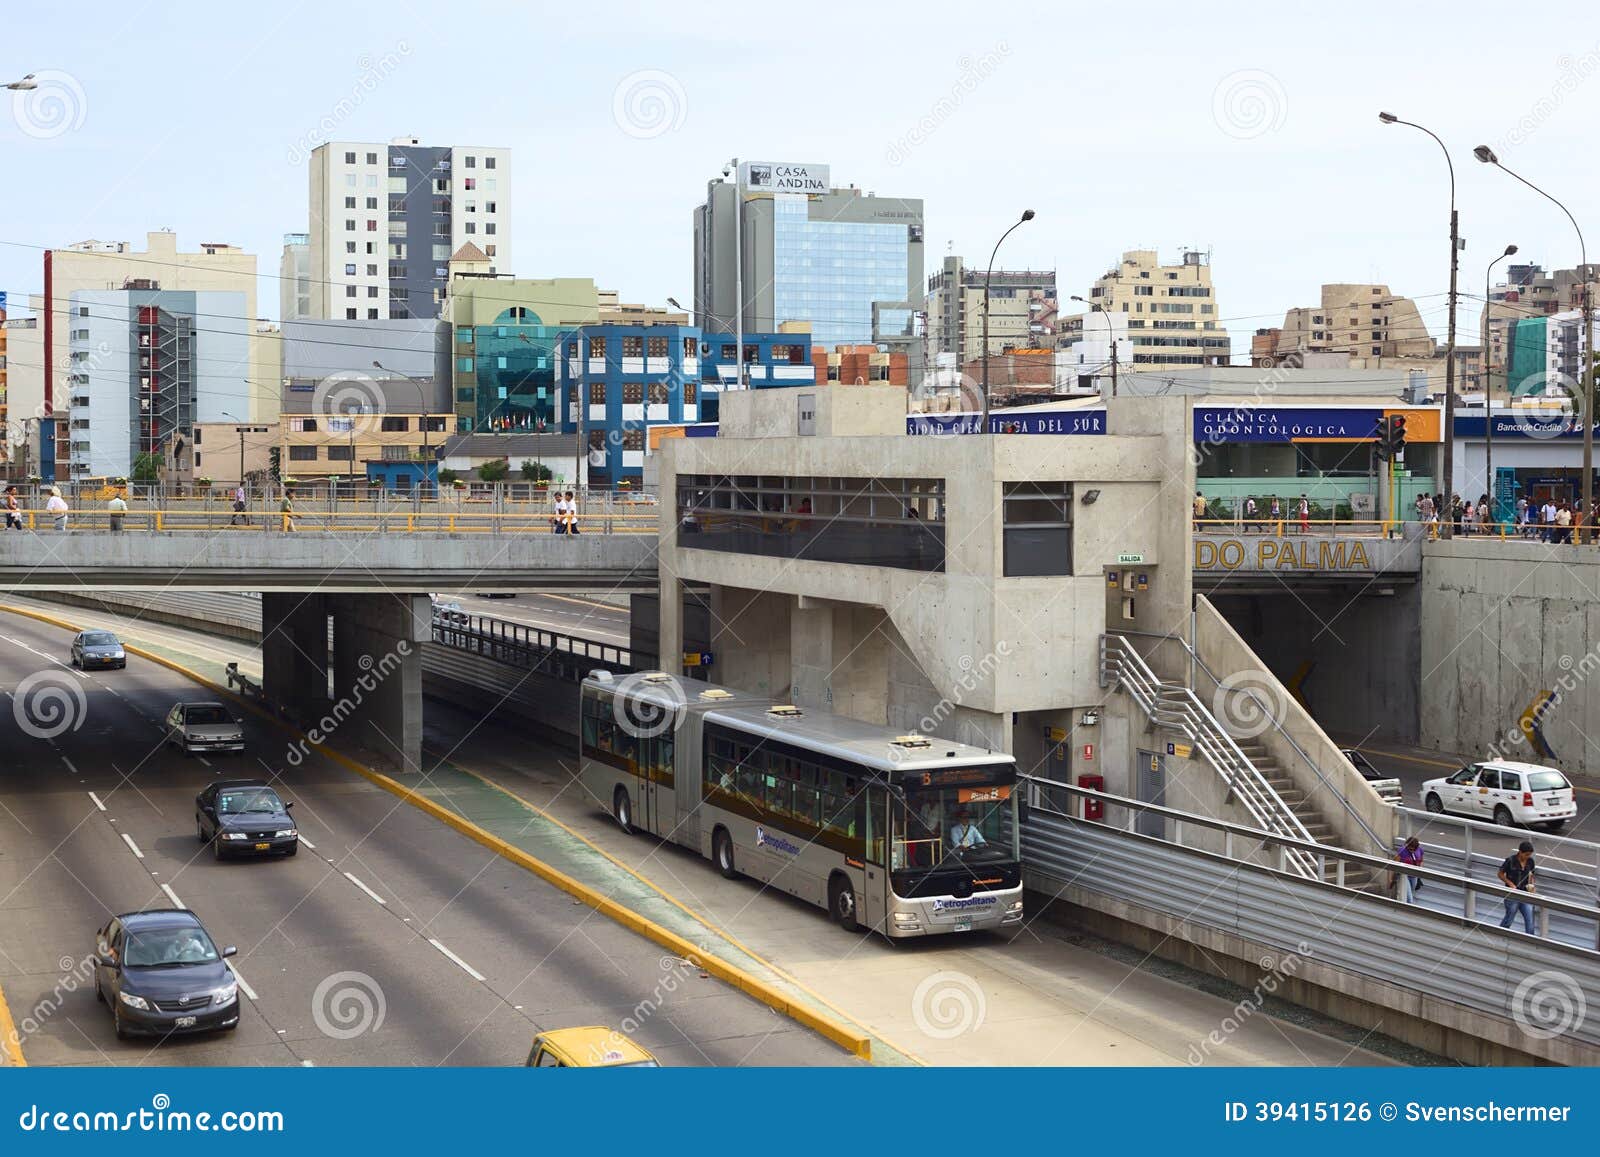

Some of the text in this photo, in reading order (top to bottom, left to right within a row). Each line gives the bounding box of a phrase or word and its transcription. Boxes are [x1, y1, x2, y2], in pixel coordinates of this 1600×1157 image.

[776, 167, 808, 177] CASA
[777, 179, 824, 189] ANDINA
[1204, 412, 1278, 423] CLÍNICA
[1038, 419, 1063, 431] DEL
[1073, 418, 1101, 431] SUR
[1204, 424, 1346, 435] ODONTOLÓGICA
[1497, 422, 1521, 432] Banco
[1533, 422, 1562, 432] Crédito
[1195, 540, 1369, 569] DO PALMA
[933, 895, 997, 911] Metropolitano
